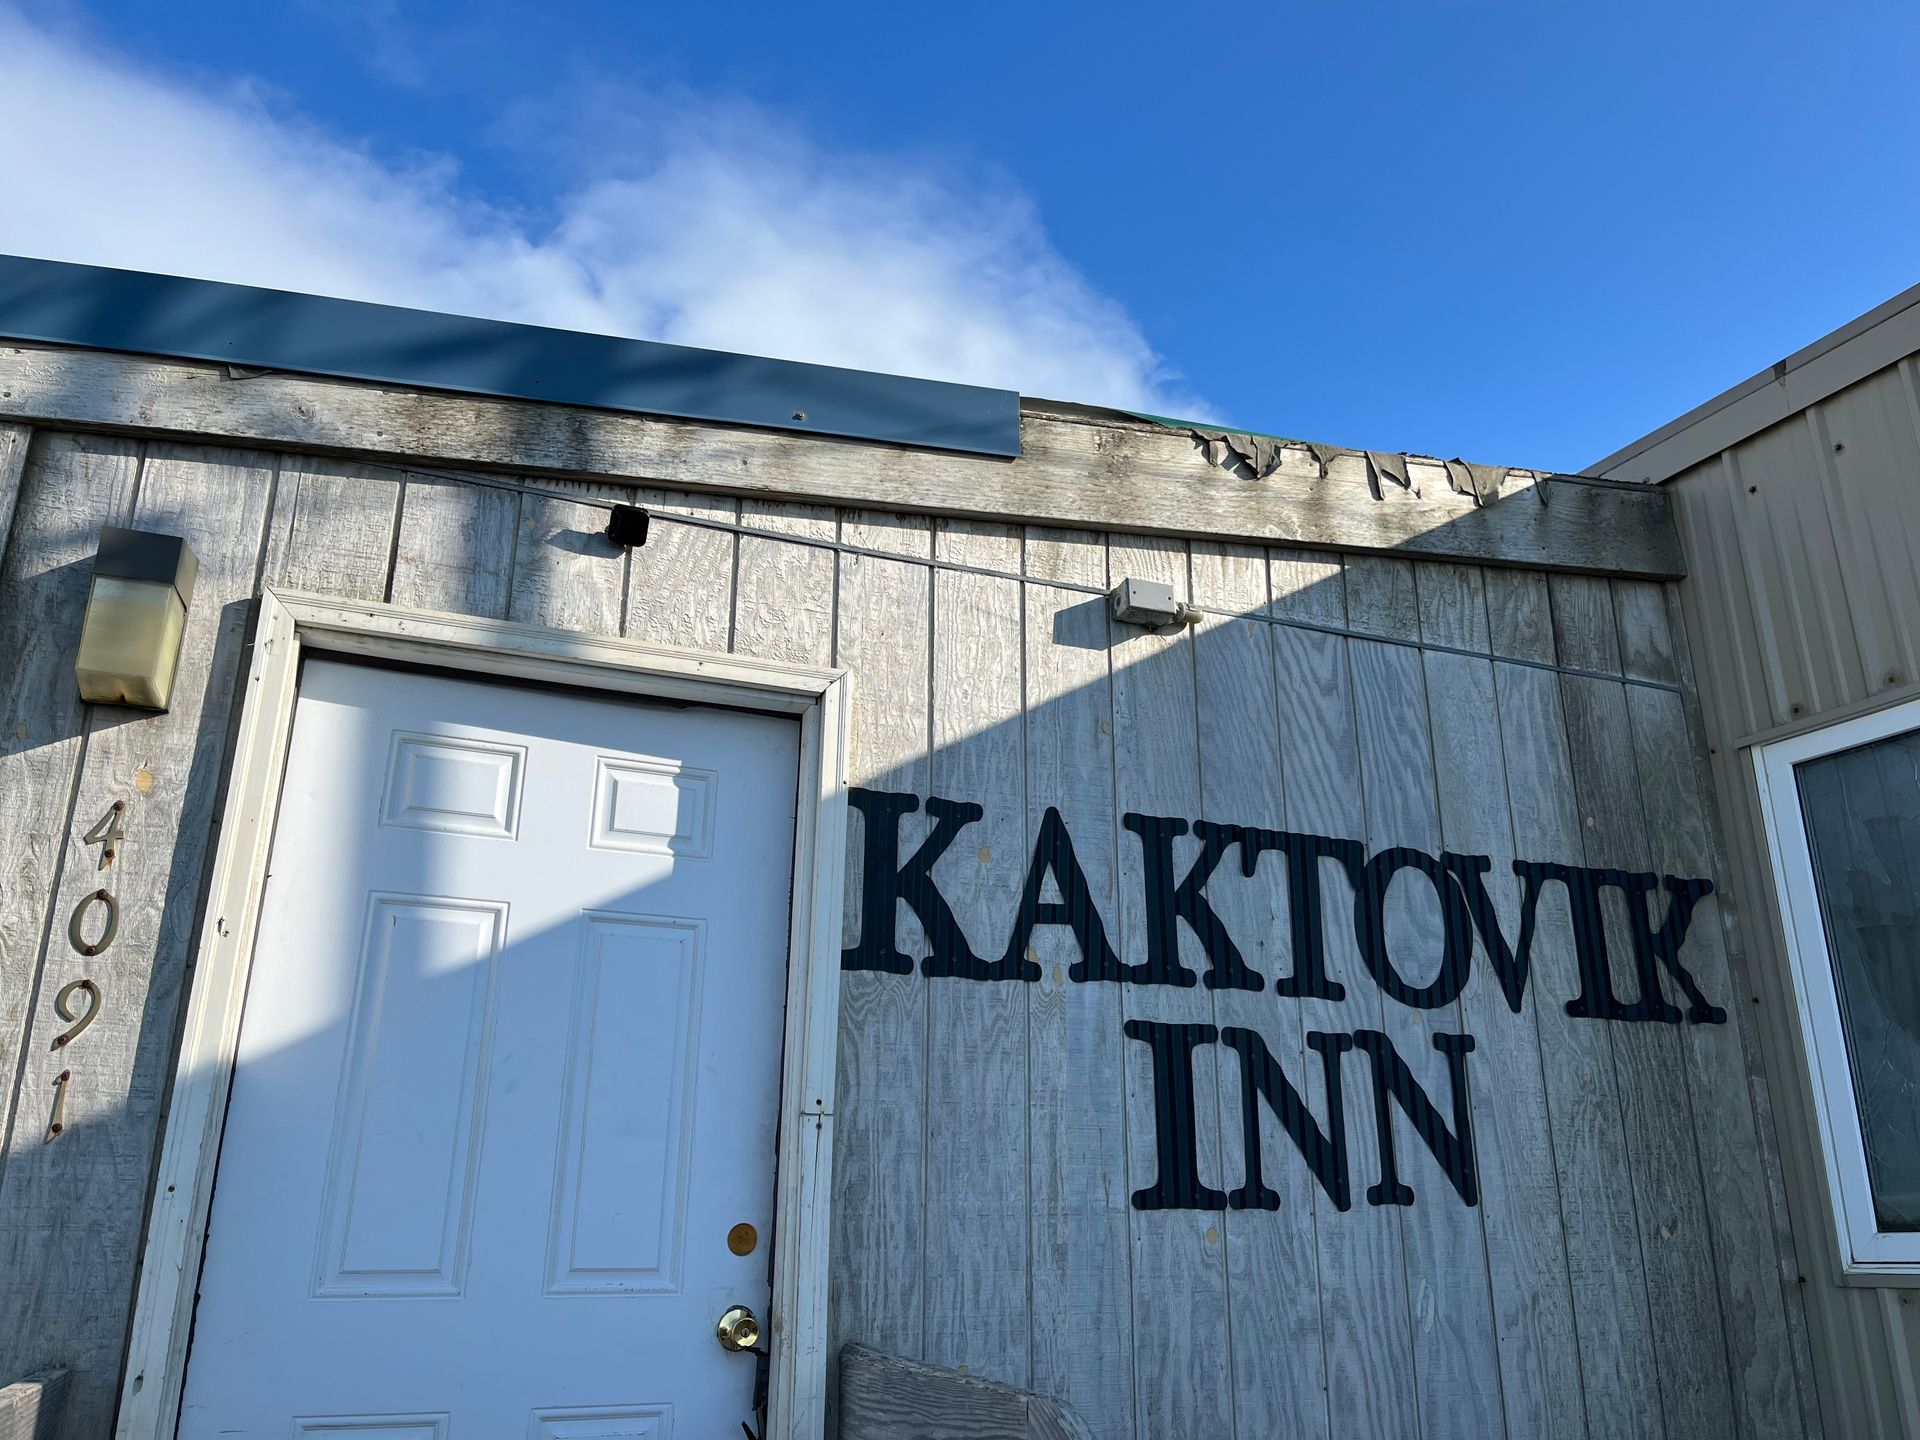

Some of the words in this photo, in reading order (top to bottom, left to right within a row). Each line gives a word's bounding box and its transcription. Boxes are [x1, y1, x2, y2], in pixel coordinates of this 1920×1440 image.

[44, 799, 126, 1144] 4091
[842, 787, 1728, 1025] KAKTOVIK
[1123, 1019, 1479, 1213] INN
